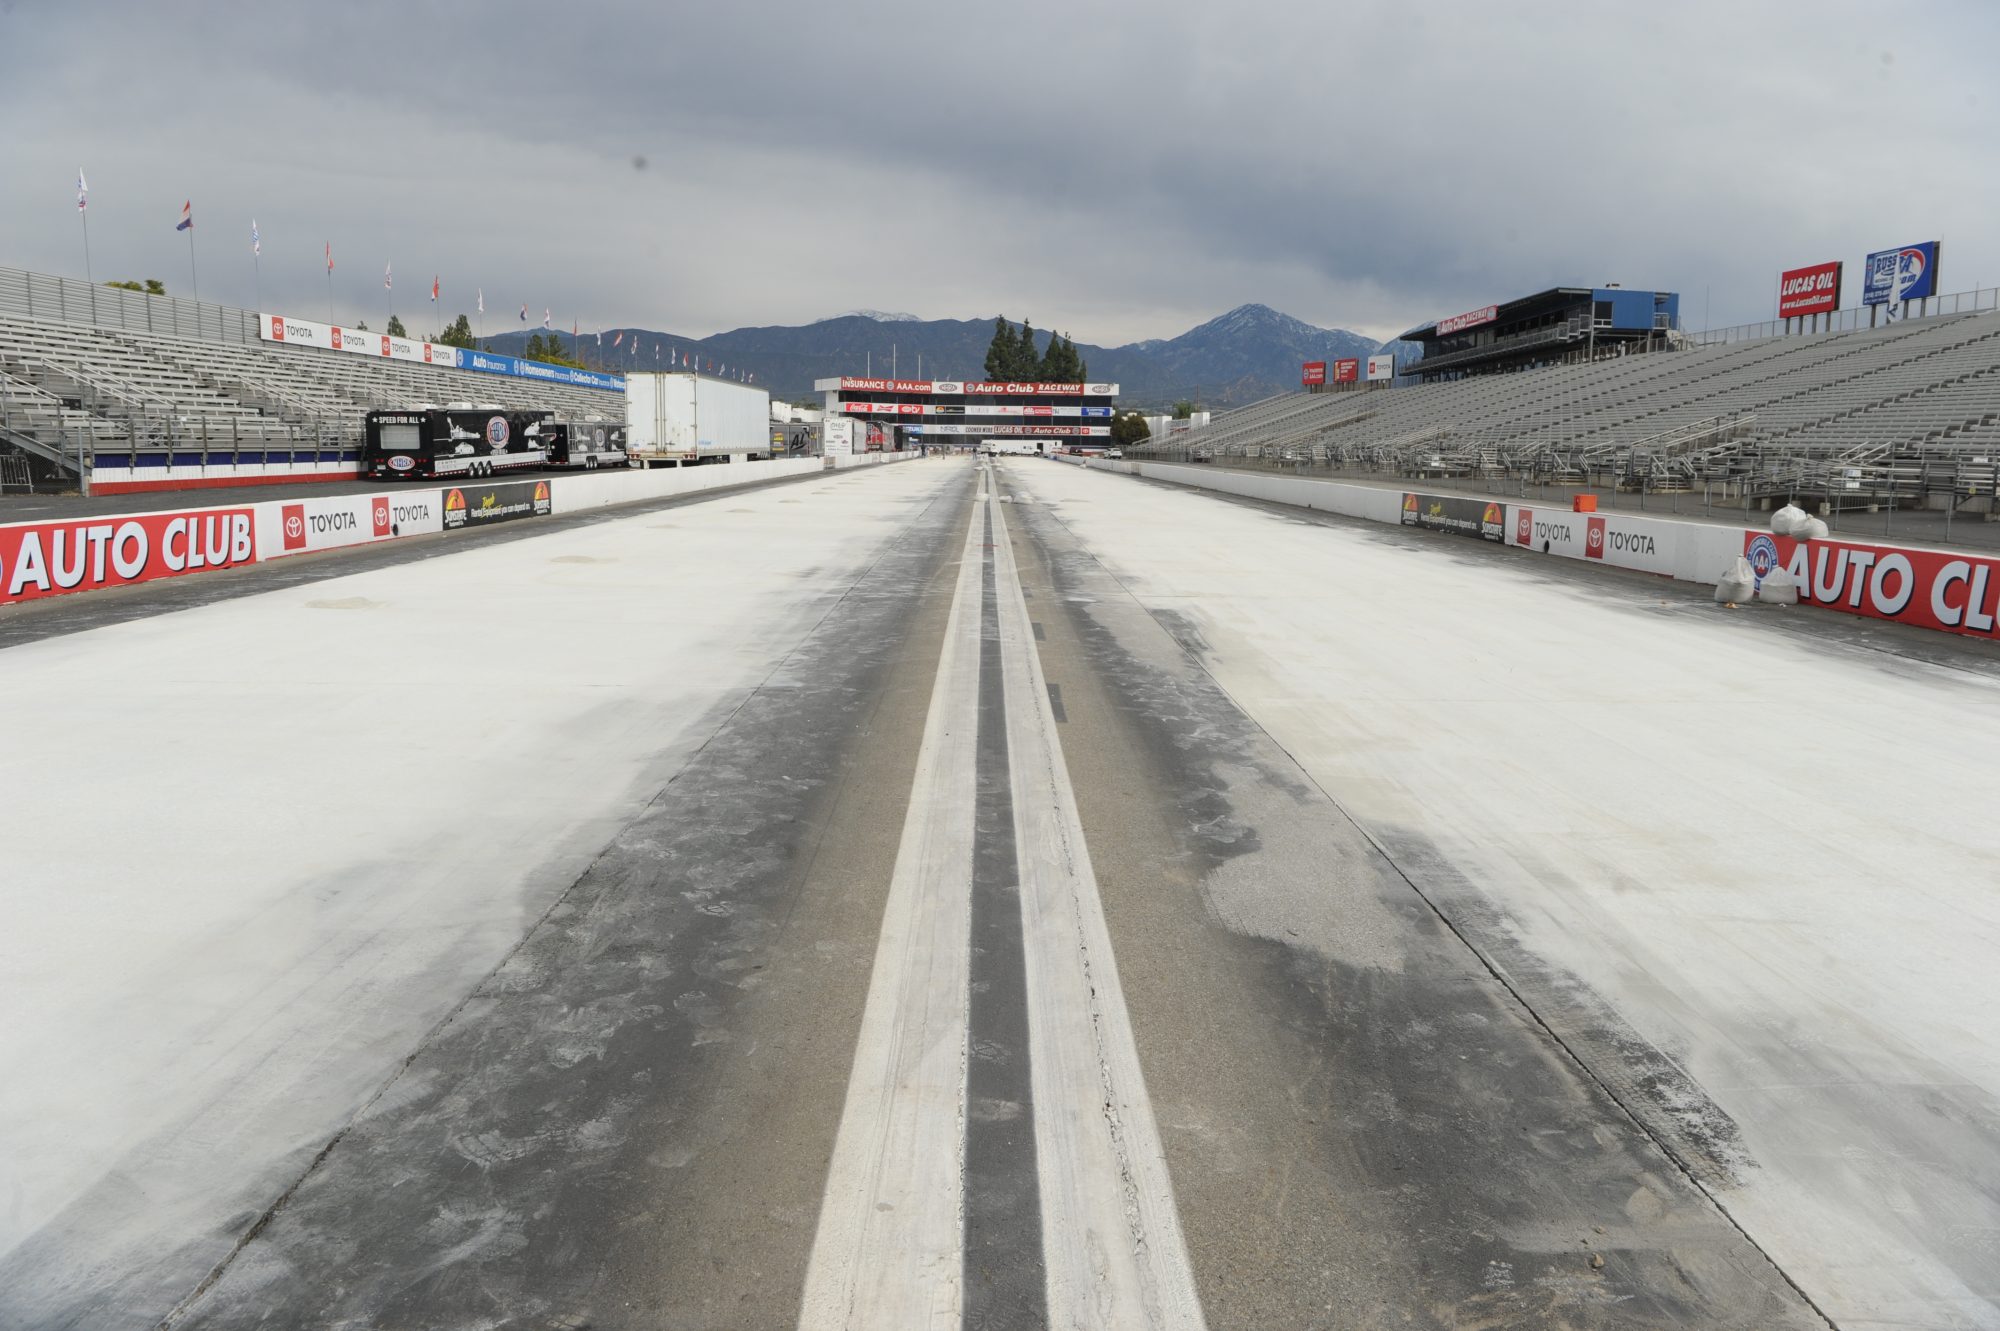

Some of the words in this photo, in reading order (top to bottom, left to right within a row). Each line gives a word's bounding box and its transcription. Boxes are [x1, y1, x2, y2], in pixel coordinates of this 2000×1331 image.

[1782, 275, 1815, 296] LUCAS
[1816, 271, 1834, 291] OIL
[286, 325, 313, 339] TOYOTA
[1441, 321, 1453, 334] Auto
[1454, 316, 1466, 331] Club
[343, 334, 366, 347] TOYOTA
[391, 343, 411, 354] TOYOTA
[432, 350, 451, 360] TOYOTA
[472, 354, 487, 369] Auto
[842, 380, 885, 390] INSURANCE
[896, 383, 931, 392] AAA.com
[975, 383, 1004, 393] Auto
[1006, 383, 1034, 393] Club
[379, 416, 397, 424] SPEED
[397, 416, 408, 424] FOR
[408, 416, 420, 424] ALL
[994, 426, 1013, 434] LUCAS
[393, 505, 429, 523] TOYOTA
[309, 512, 357, 534] TOYOTA
[1535, 521, 1571, 542] TOYOTA
[1608, 531, 1655, 555] TOYOTA
[8, 521, 149, 595] AUTO
[162, 513, 252, 572] CLUB
[1786, 543, 1914, 616] AUTO
[1931, 560, 2000, 632] CL
